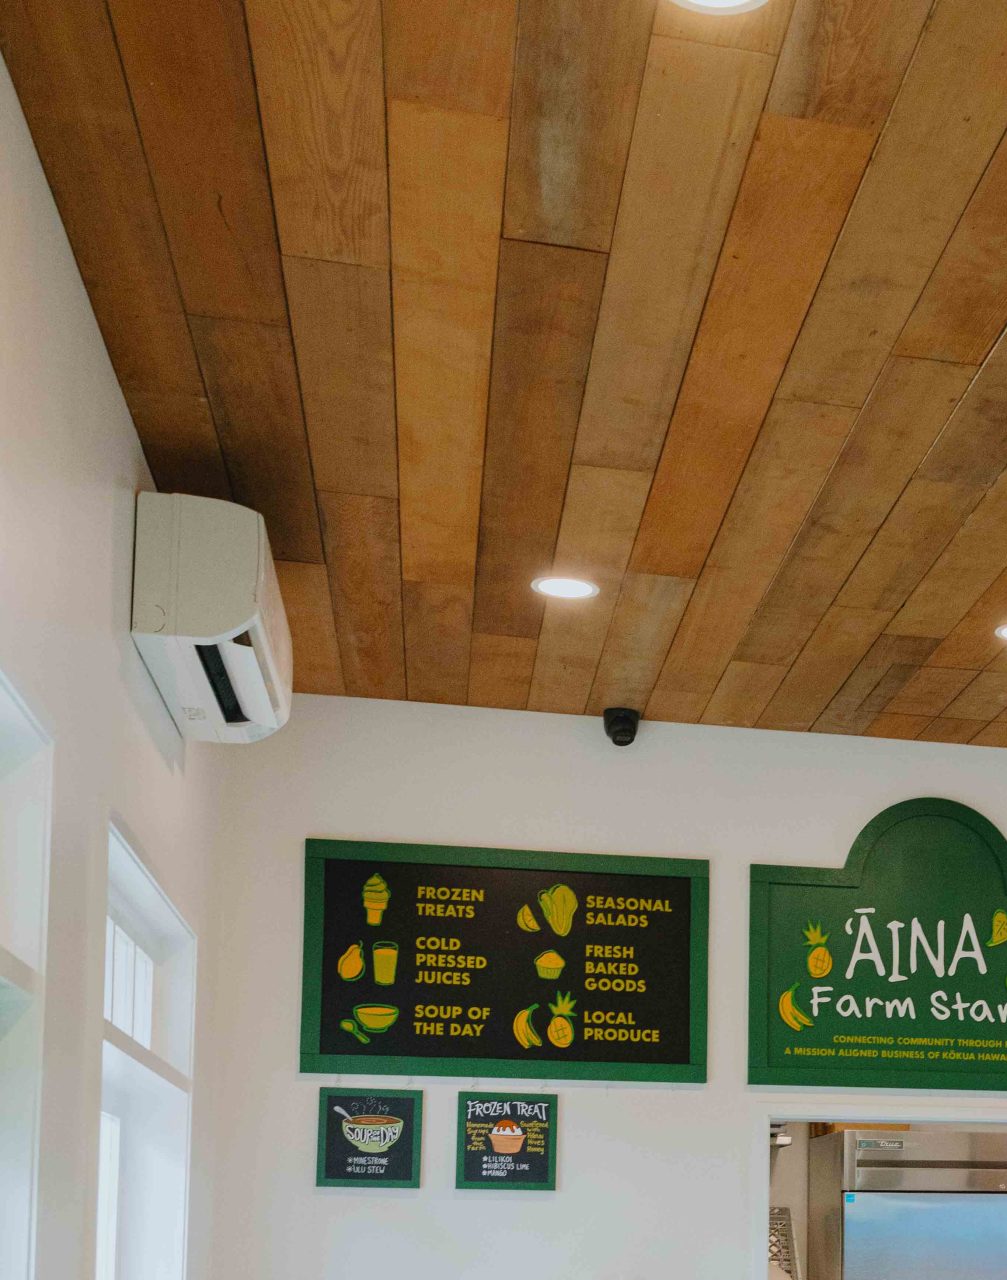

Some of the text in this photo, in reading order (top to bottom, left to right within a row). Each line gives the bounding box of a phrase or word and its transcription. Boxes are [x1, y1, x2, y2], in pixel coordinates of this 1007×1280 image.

[417, 886, 484, 902] FROZEN
[416, 903, 475, 918] TREATS
[586, 896, 672, 913] SEASONAL
[586, 912, 648, 928] SALADS
[416, 937, 460, 951] COLD
[585, 945, 634, 959] FRESH
[416, 954, 487, 969] PRESSED
[585, 961, 639, 976] BAKED
[415, 970, 471, 986] JUICES
[585, 978, 646, 993] GOODS
[810, 986, 916, 1019] Farm
[415, 1005, 491, 1020] SOUP OF
[584, 1011, 635, 1025] LOCAL
[414, 1022, 485, 1037] THE DAY
[584, 1028, 660, 1042] PRODUCE
[833, 1035, 894, 1045] CONNECTING
[897, 1037, 954, 1047] COMMUNITY
[958, 1039, 1002, 1048] THROUGH
[785, 1047, 791, 1055] A
[794, 1047, 835, 1057] MISSION
[838, 1049, 877, 1058] ALIGNED
[881, 1050, 925, 1059] BUSINESS
[928, 1051, 940, 1060] OF
[467, 1101, 549, 1120] FROZEN TREAT
[346, 1125, 398, 1146] SOUP DAY
